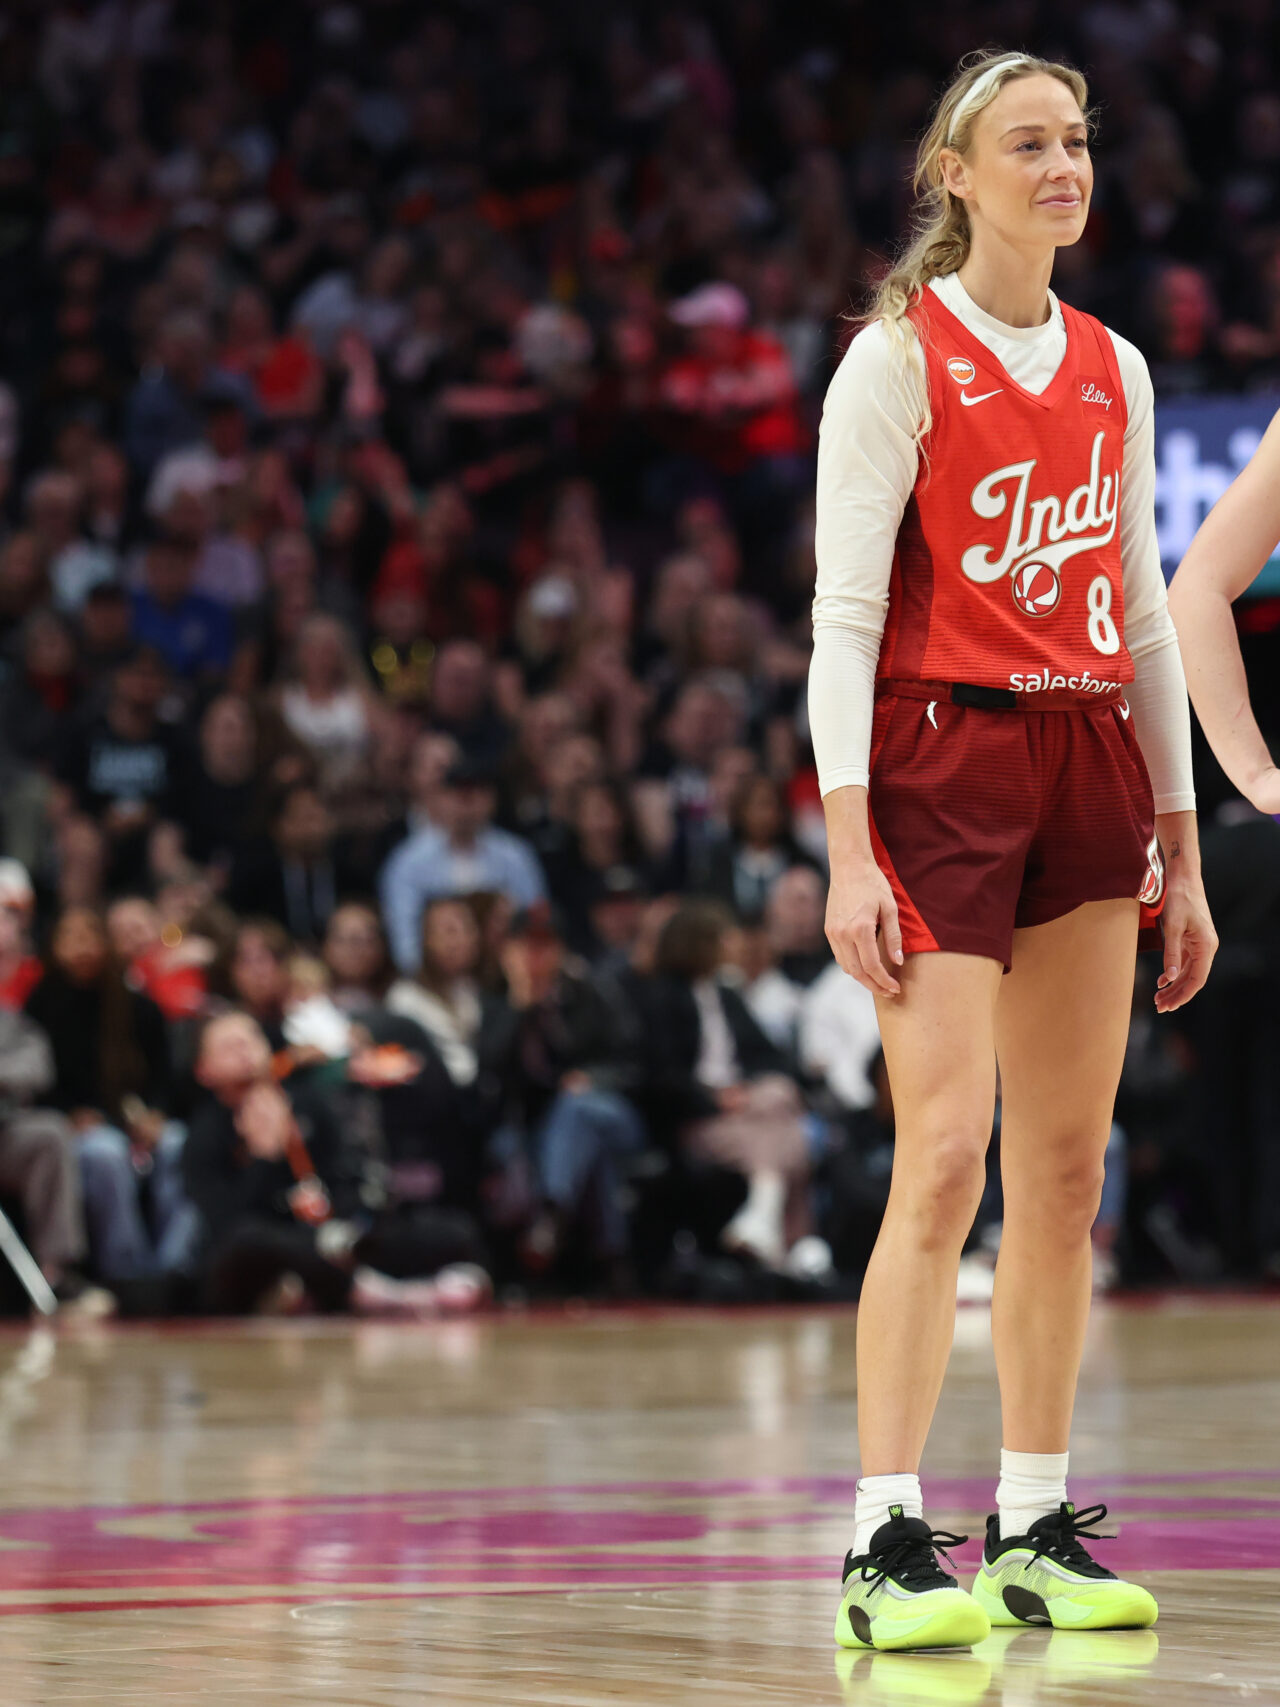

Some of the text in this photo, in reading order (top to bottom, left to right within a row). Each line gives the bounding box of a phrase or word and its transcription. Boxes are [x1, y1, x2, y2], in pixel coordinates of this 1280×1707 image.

[1080, 383, 1113, 411] Lilly
[960, 430, 1120, 584] Indy
[1086, 575, 1121, 656] 8
